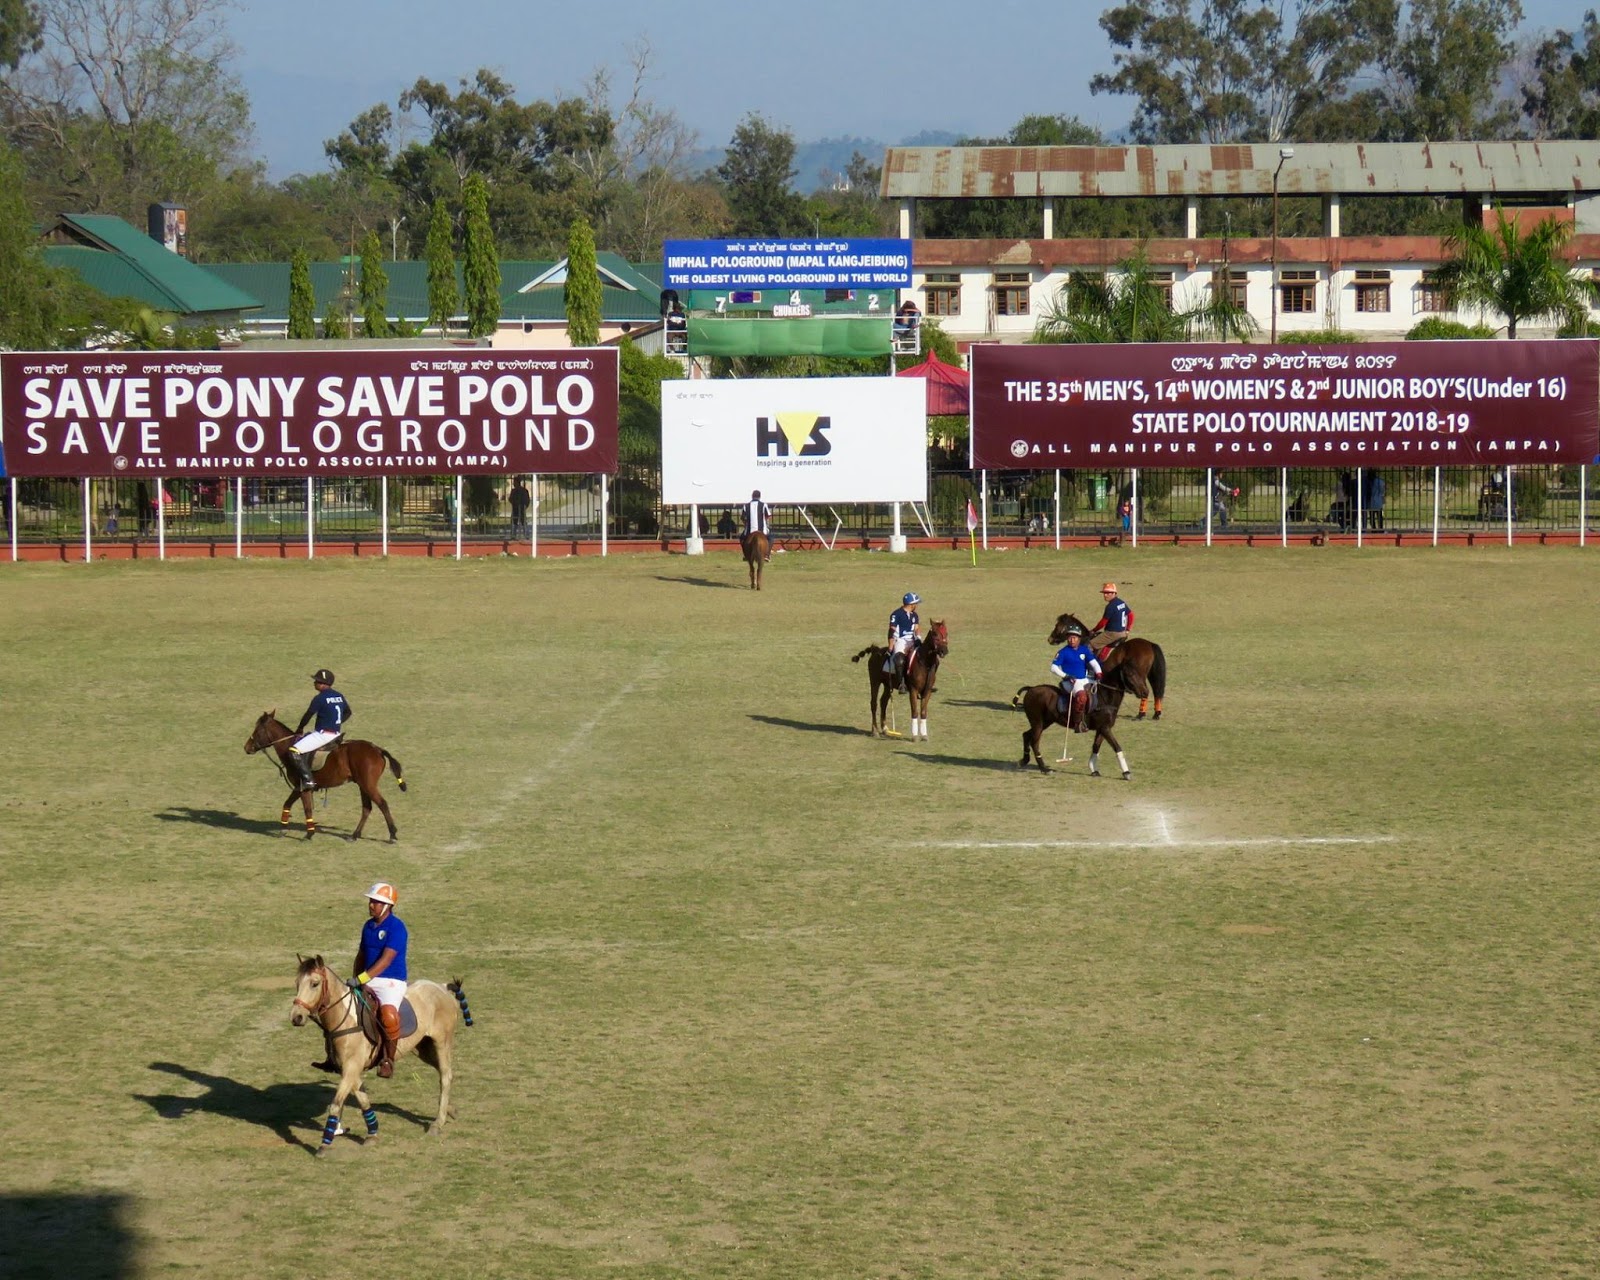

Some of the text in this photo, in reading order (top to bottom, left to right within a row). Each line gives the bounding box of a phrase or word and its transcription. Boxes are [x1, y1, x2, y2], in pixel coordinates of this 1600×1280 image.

[669, 255, 907, 270] IMPHAL POLOGROUND (MAPAL KANGJEIBUNG)
[669, 273, 908, 283] THE OLDEST LIVING POLOGROUND IN THE WORLD
[716, 297, 725, 312] 7
[790, 289, 800, 305] 4
[869, 294, 879, 310] 2
[25, 375, 593, 418] SAVE PONY SAVE POLO
[1004, 382, 1041, 401] THE
[1047, 380, 1082, 402] 35th
[1084, 381, 1149, 403] MEN'S,
[1155, 380, 1189, 401] 14th
[1192, 379, 1285, 400] WOMEN'S
[1290, 379, 1304, 399] &
[1307, 377, 1329, 399] 2nd
[1333, 379, 1404, 399] JUNIOR
[1538, 377, 1565, 400] 16)
[1133, 412, 1469, 433] STATE POLO TOURNAMENT 2018-19
[28, 419, 594, 454] SAVE POLOGROUND
[1032, 441, 1559, 453] ALL MANIPUR POLO ASSOCIATION (AMPA)
[136, 456, 507, 467] ALL MANIPUR POLO ASSOCIATION (AMPA)
[756, 459, 786, 467] Inspiring
[795, 459, 832, 467] generation
[335, 705, 341, 725] 1
